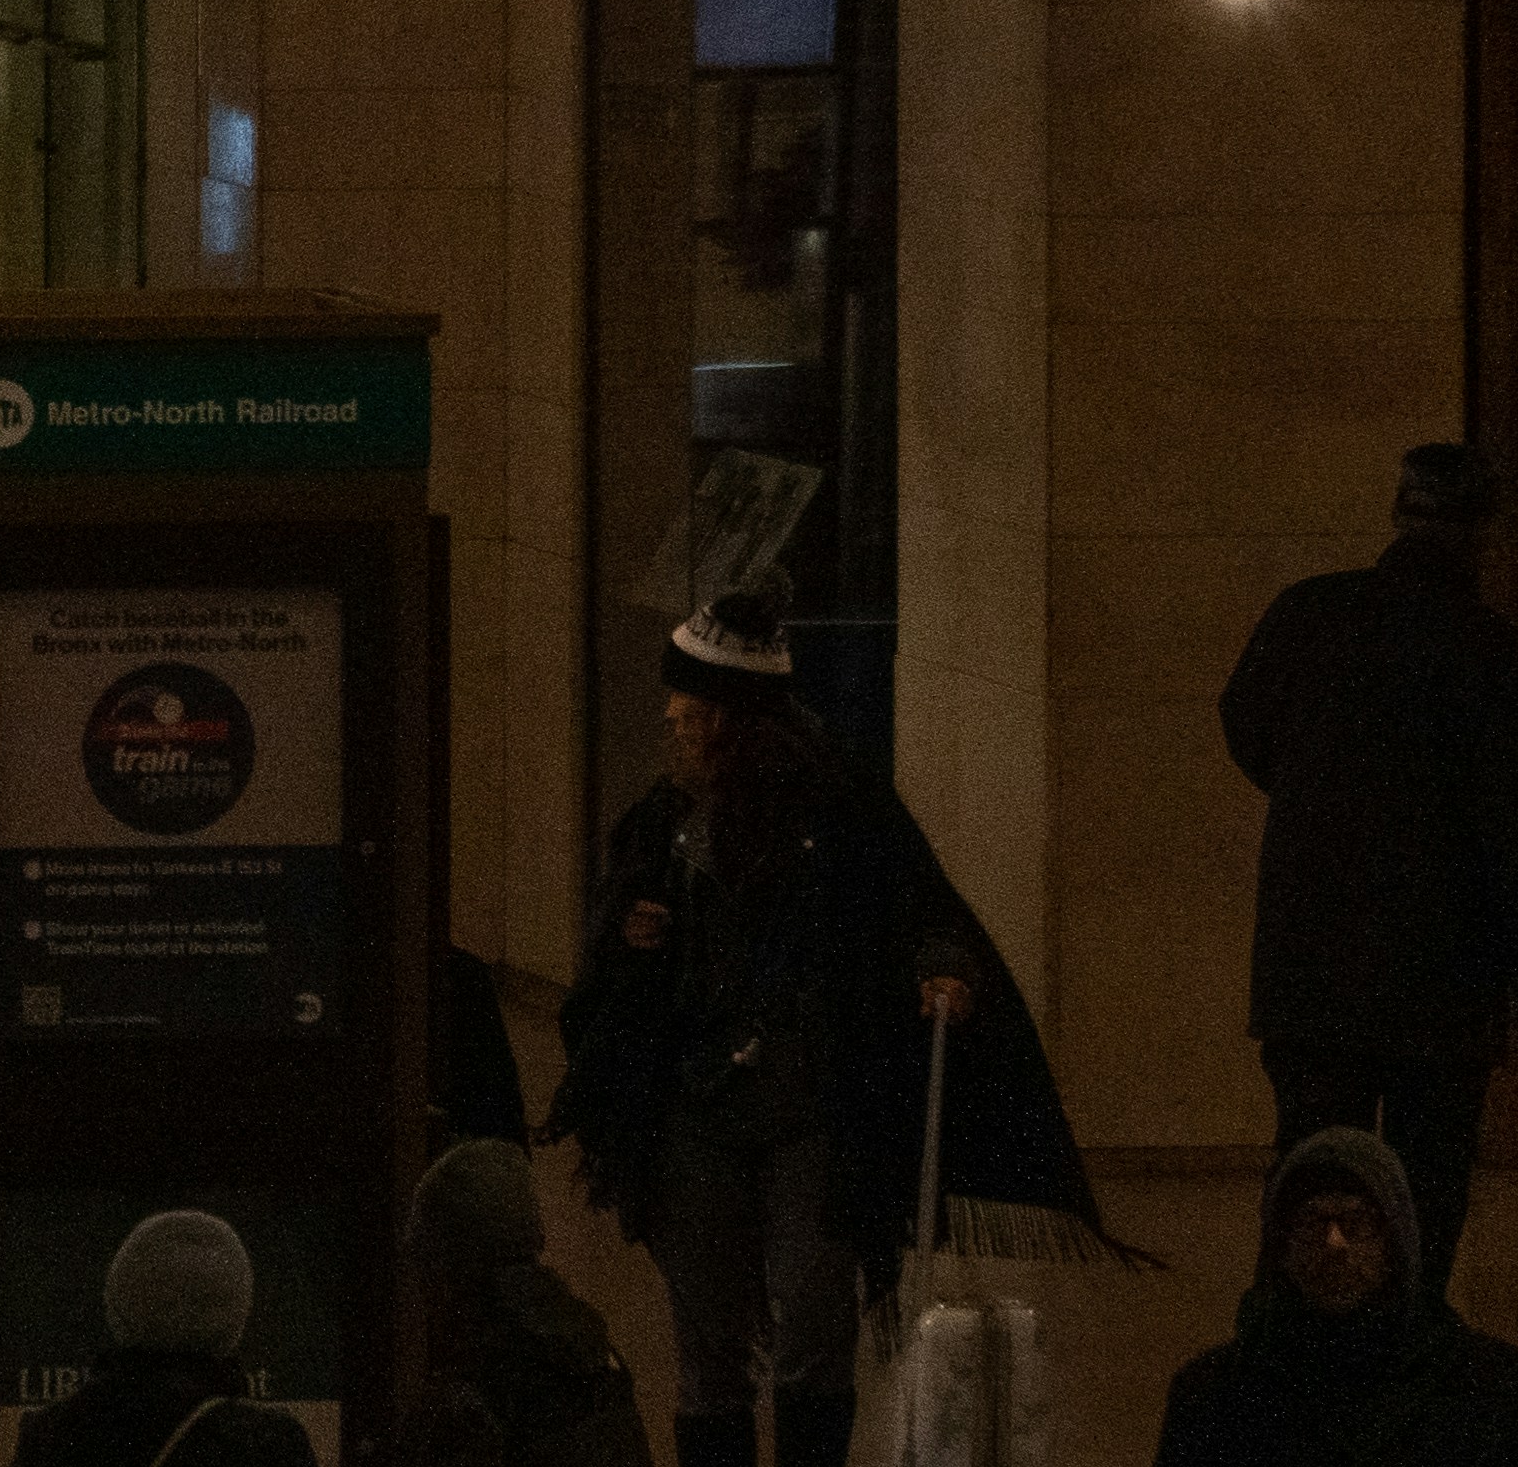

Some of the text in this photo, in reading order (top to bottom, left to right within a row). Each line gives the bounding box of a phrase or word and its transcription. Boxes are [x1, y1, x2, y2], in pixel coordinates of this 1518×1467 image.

[46, 399, 225, 427] Metro-North
[236, 396, 359, 425] Railroad
[50, 608, 117, 629] Catch
[124, 608, 222, 629] baseball
[252, 607, 288, 628] the
[33, 631, 307, 654] Bronx with Metro-North
[112, 743, 191, 774] train
